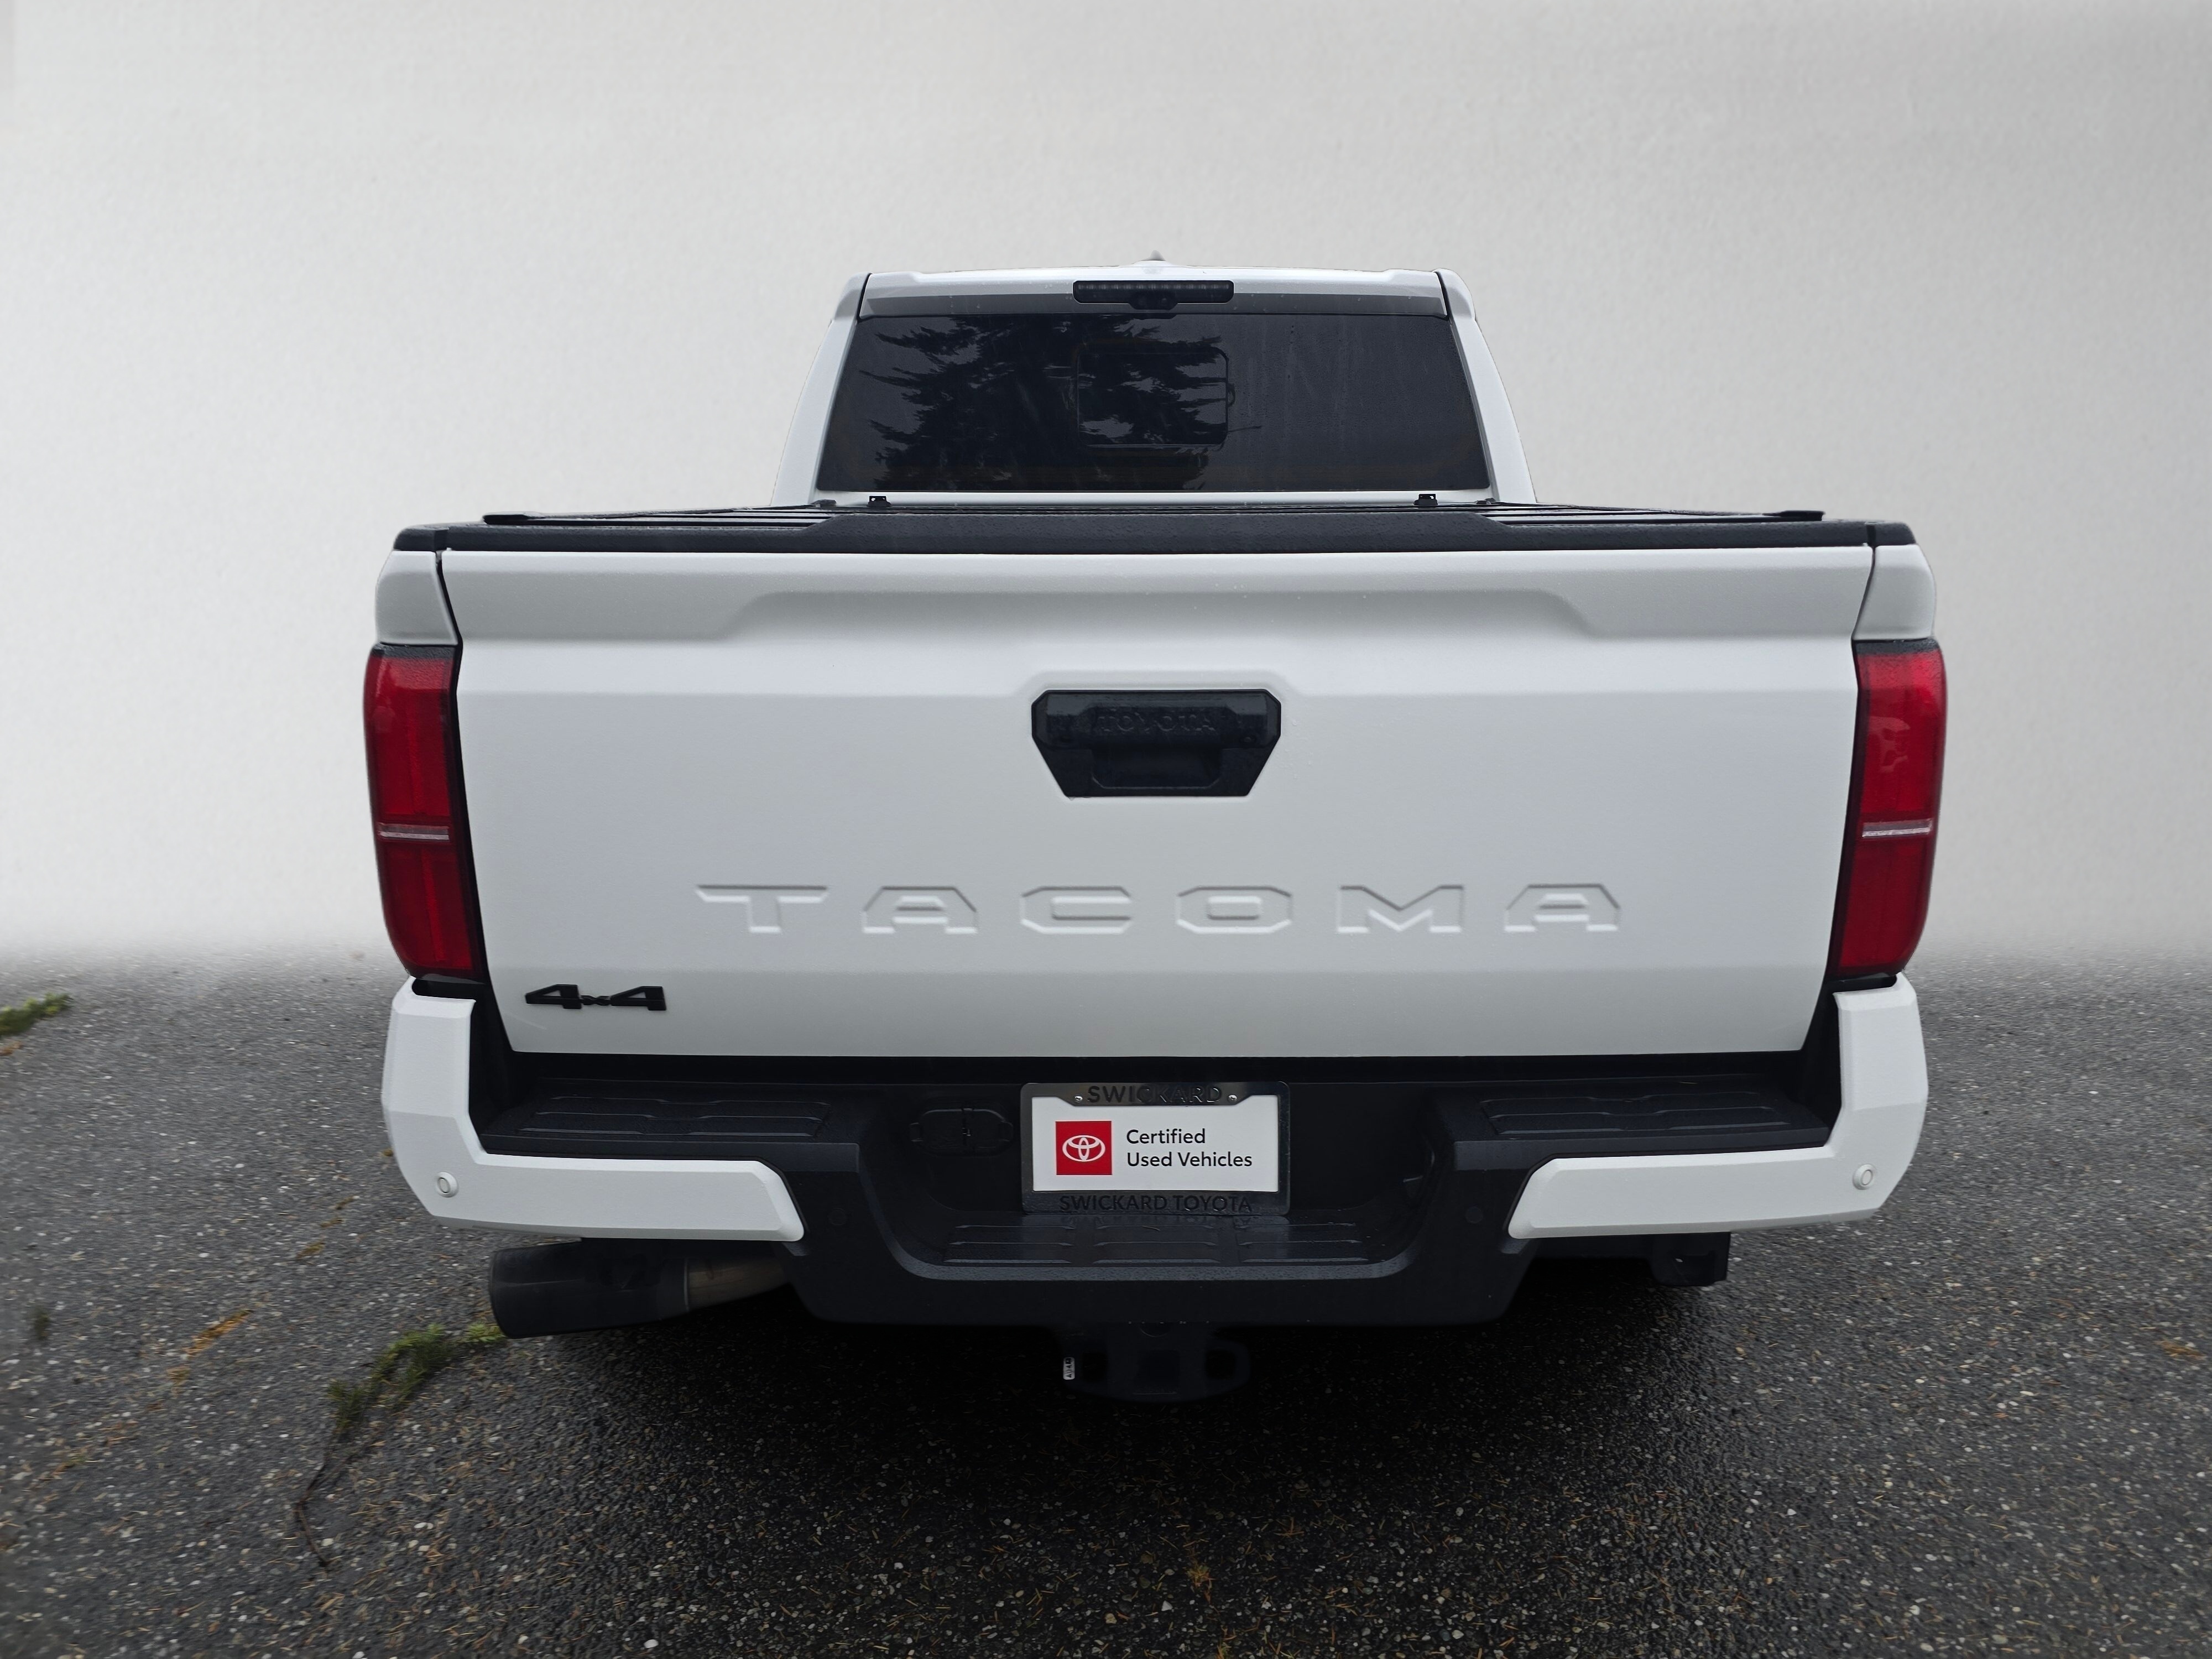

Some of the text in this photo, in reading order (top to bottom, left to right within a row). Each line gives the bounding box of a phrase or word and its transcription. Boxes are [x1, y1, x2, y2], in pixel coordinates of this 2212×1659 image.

[1097, 713, 1217, 732] TOYOTA
[693, 884, 1622, 935] TACOMA
[1087, 1086, 1222, 1104] SWICKARD
[1126, 1129, 1206, 1144] Certified
[1126, 1151, 1253, 1167] Used Vehicles
[1060, 1194, 1253, 1212] SWICKARD TOYOTA
